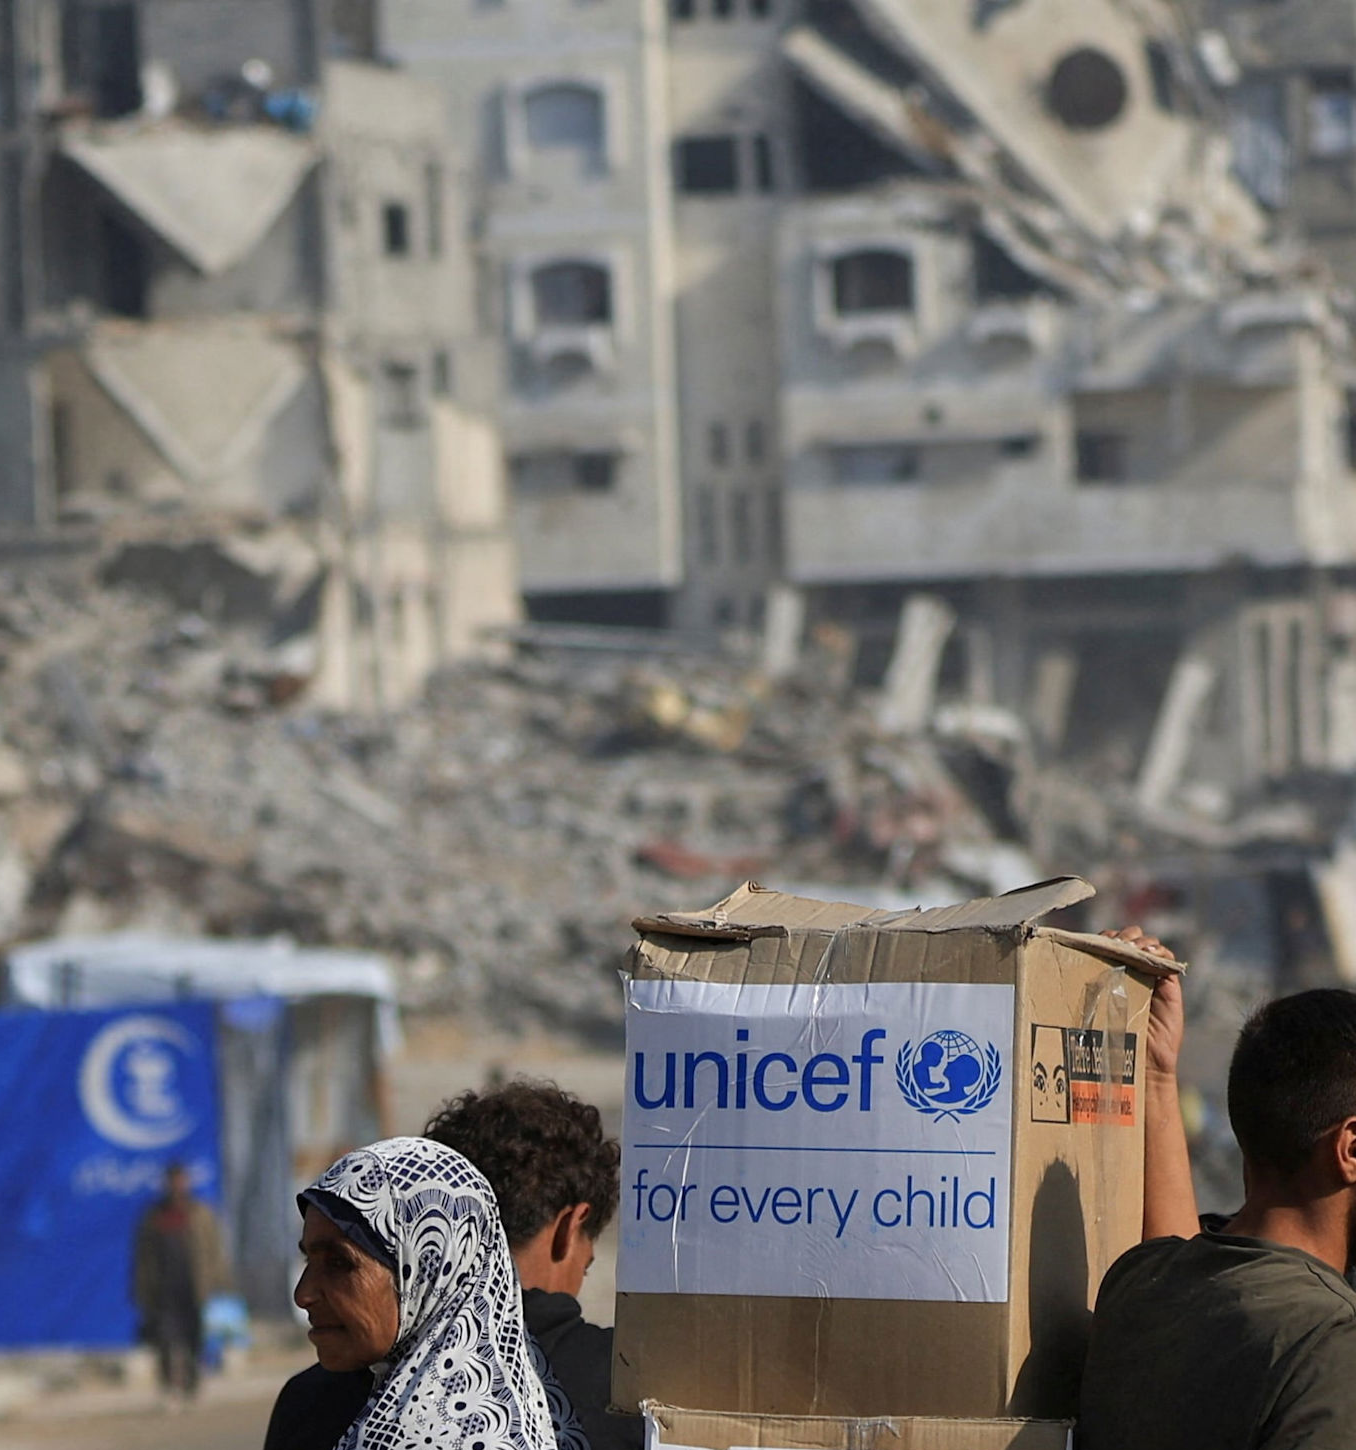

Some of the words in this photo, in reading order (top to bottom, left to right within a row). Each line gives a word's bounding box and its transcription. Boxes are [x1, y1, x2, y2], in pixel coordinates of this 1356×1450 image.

[634, 1028, 886, 1112] unicef
[632, 1168, 697, 1222] for
[709, 1184, 858, 1238] every
[872, 1175, 995, 1229] child
